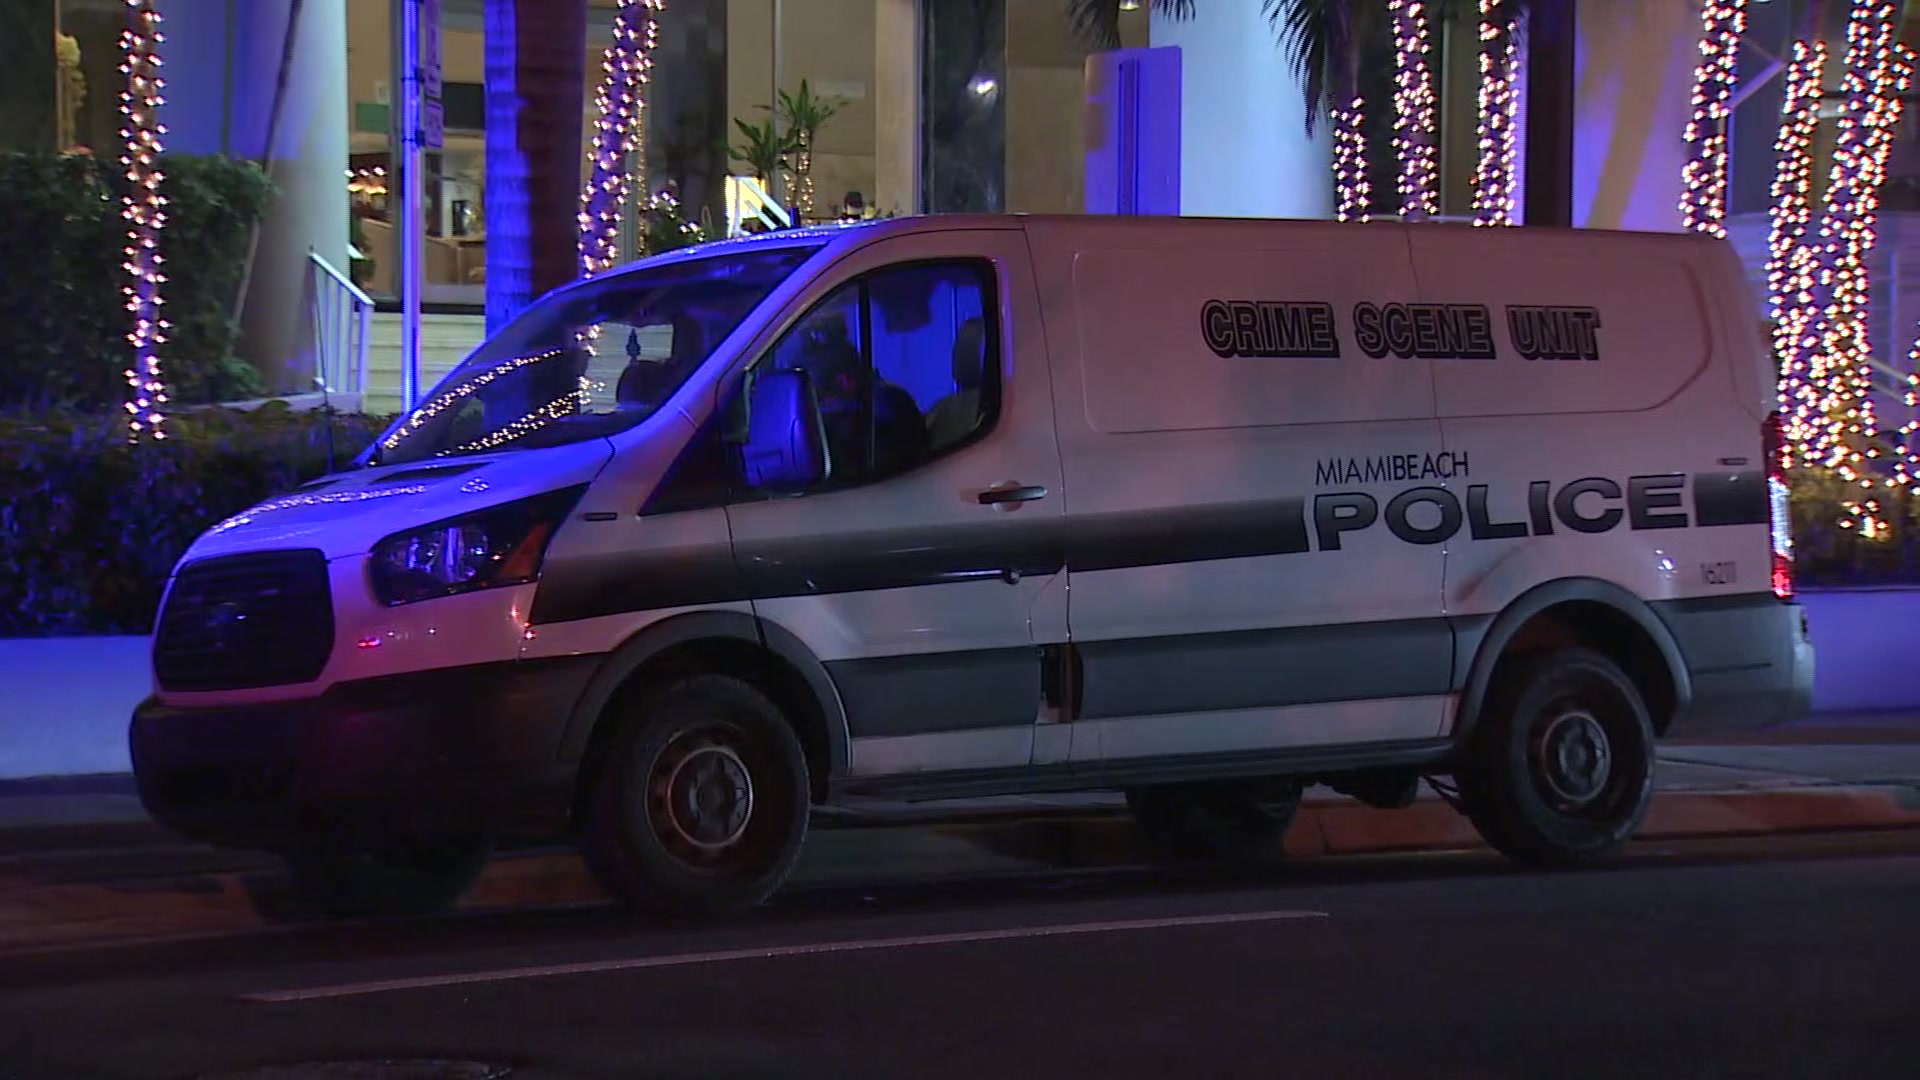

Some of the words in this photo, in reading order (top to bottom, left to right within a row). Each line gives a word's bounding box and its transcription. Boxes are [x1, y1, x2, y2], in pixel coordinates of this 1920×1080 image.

[1200, 300, 1340, 358] CRIME
[1354, 301, 1496, 359] SCENE
[1505, 304, 1602, 360] UNIT
[1315, 451, 1469, 486] MIAMIBEACH
[1313, 473, 1689, 552] POLICE
